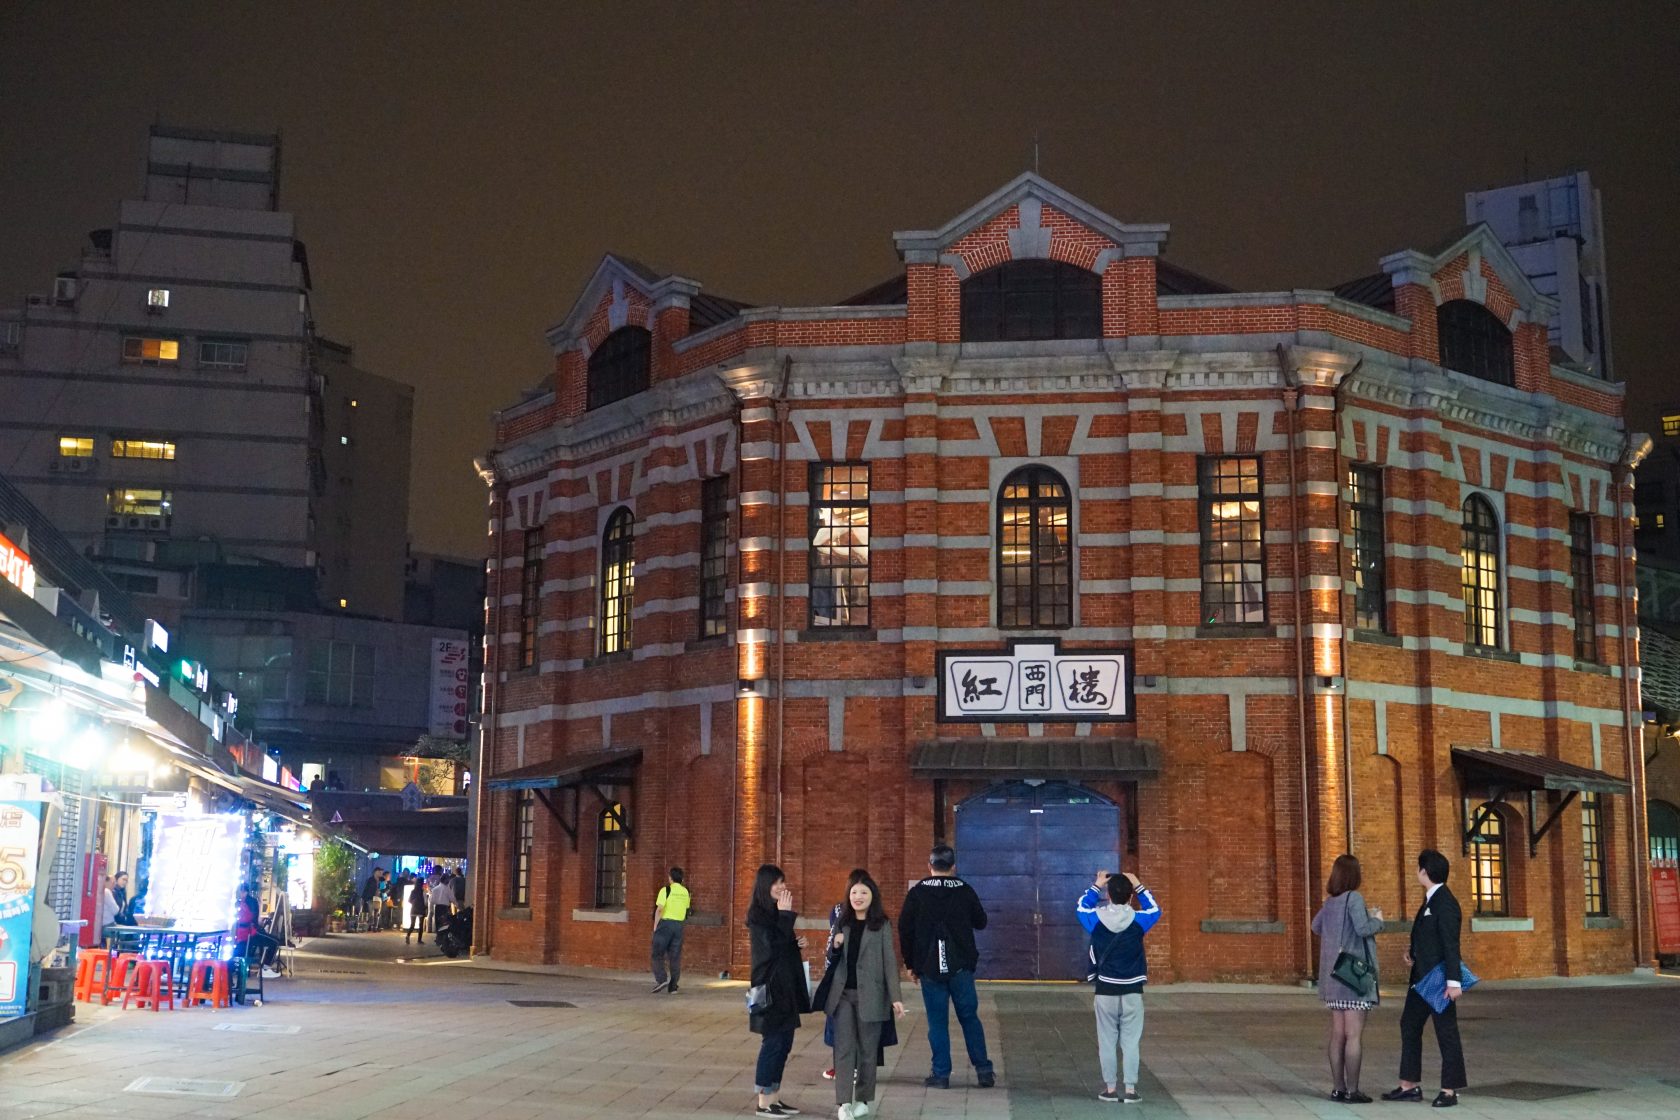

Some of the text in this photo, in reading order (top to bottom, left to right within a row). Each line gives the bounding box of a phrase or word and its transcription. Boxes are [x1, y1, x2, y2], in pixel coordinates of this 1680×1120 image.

[439, 642, 453, 652] 2F
[961, 669, 1003, 704] 紅
[1025, 664, 1046, 707] 西門
